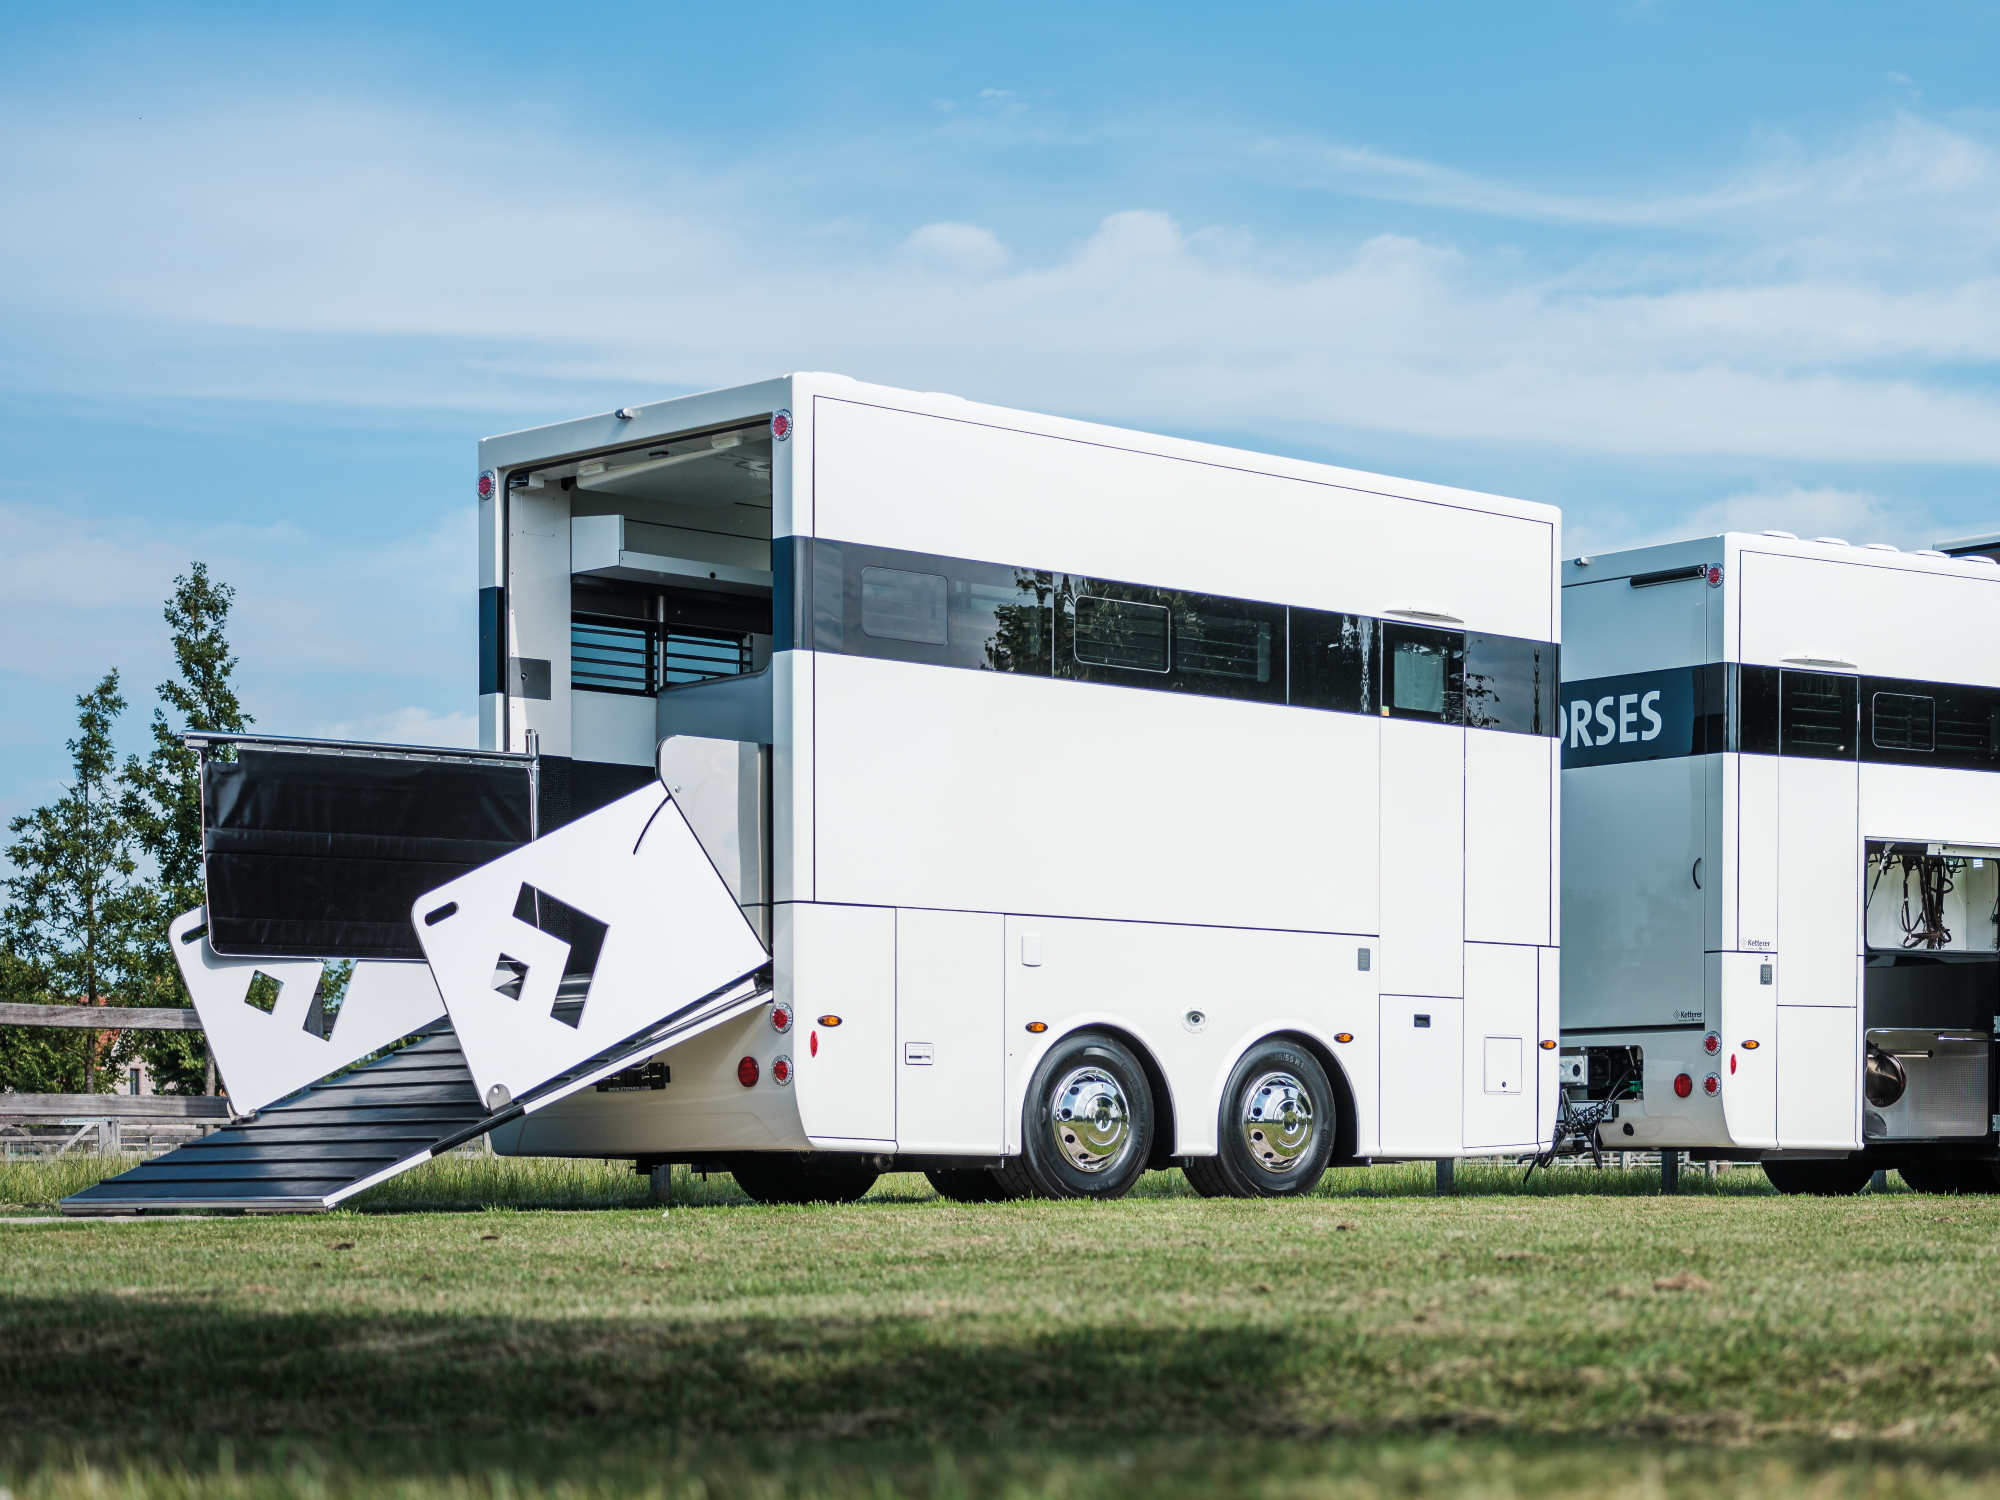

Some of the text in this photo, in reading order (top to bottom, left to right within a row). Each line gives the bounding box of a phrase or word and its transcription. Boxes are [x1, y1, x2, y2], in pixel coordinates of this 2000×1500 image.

[1560, 690, 1662, 748] RSES
[1747, 939, 1771, 947] Ketterer
[1680, 1010, 1703, 1019] Ketterer
